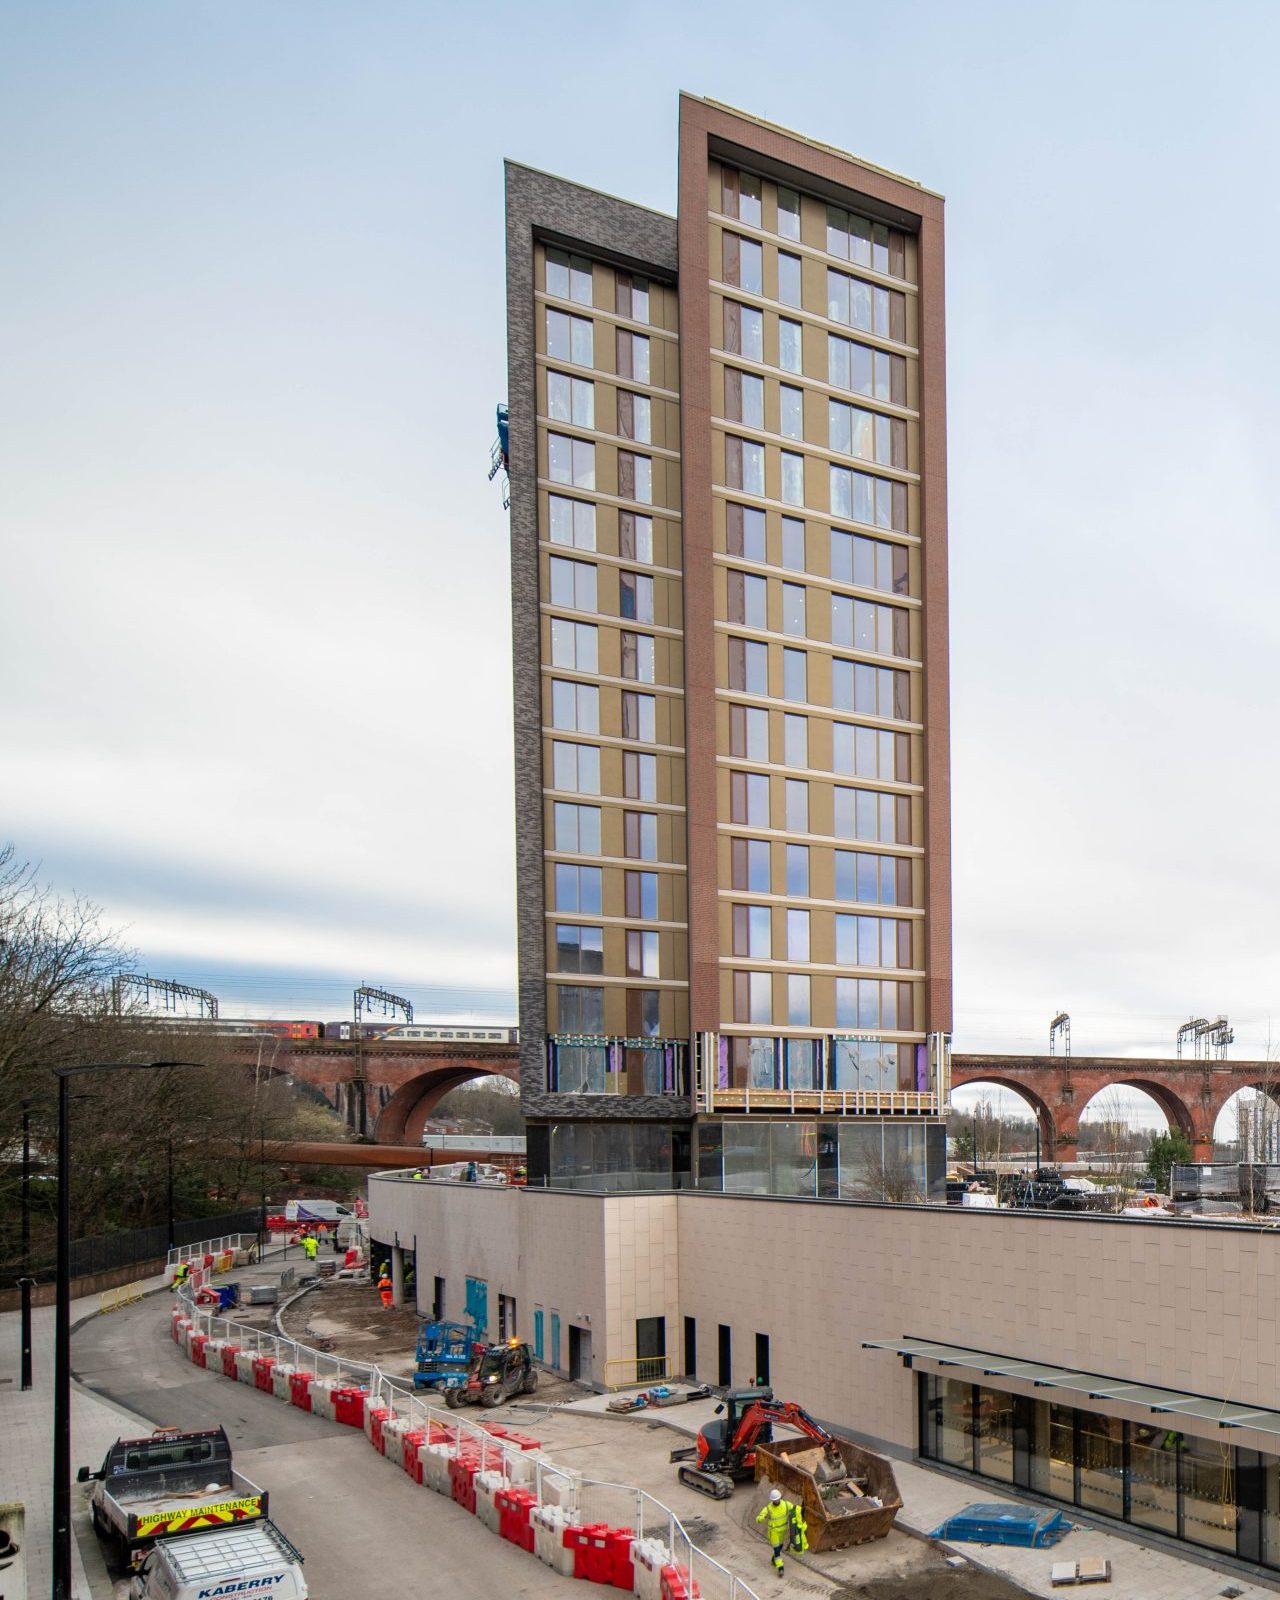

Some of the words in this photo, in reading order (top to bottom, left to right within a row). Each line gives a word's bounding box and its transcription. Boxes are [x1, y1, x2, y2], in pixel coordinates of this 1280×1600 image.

[143, 1510, 188, 1525] HIGHWAY
[190, 1498, 257, 1517] MAINTENANCE
[198, 1574, 285, 1599] KABERRY
[210, 1586, 273, 1600] CONSTRUCTION
